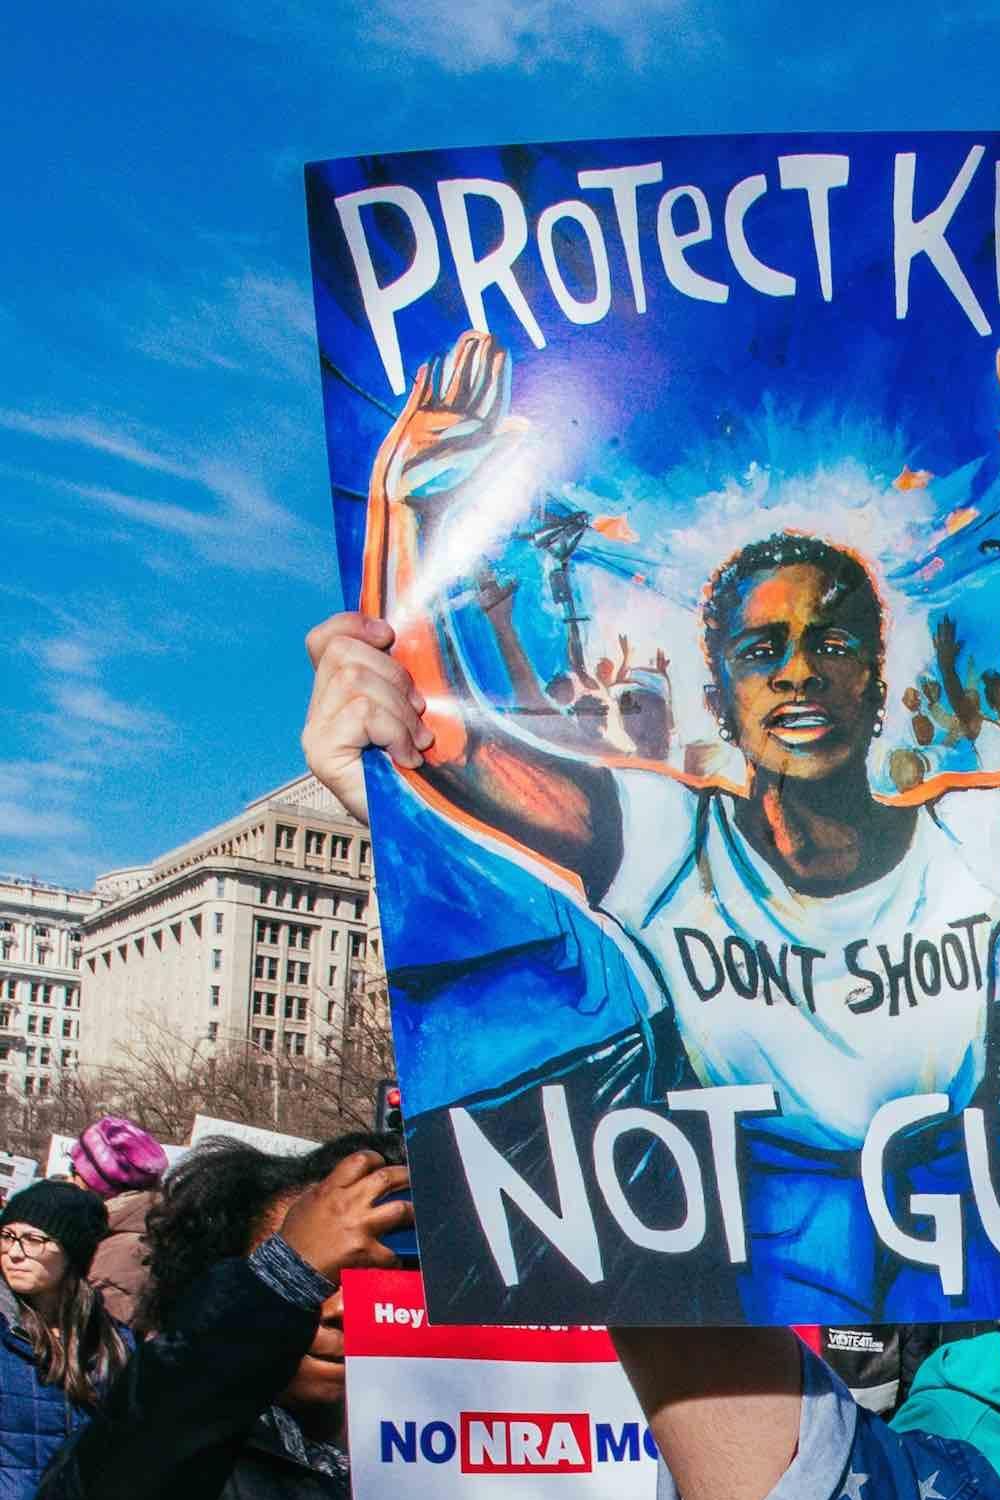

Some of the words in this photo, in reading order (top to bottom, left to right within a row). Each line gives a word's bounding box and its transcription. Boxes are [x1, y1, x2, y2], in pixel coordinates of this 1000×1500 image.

[673, 927, 826, 1014] DONT
[844, 912, 992, 1016] SHOOT
[448, 1084, 778, 1287] NOT
[374, 1302, 424, 1329] Hey
